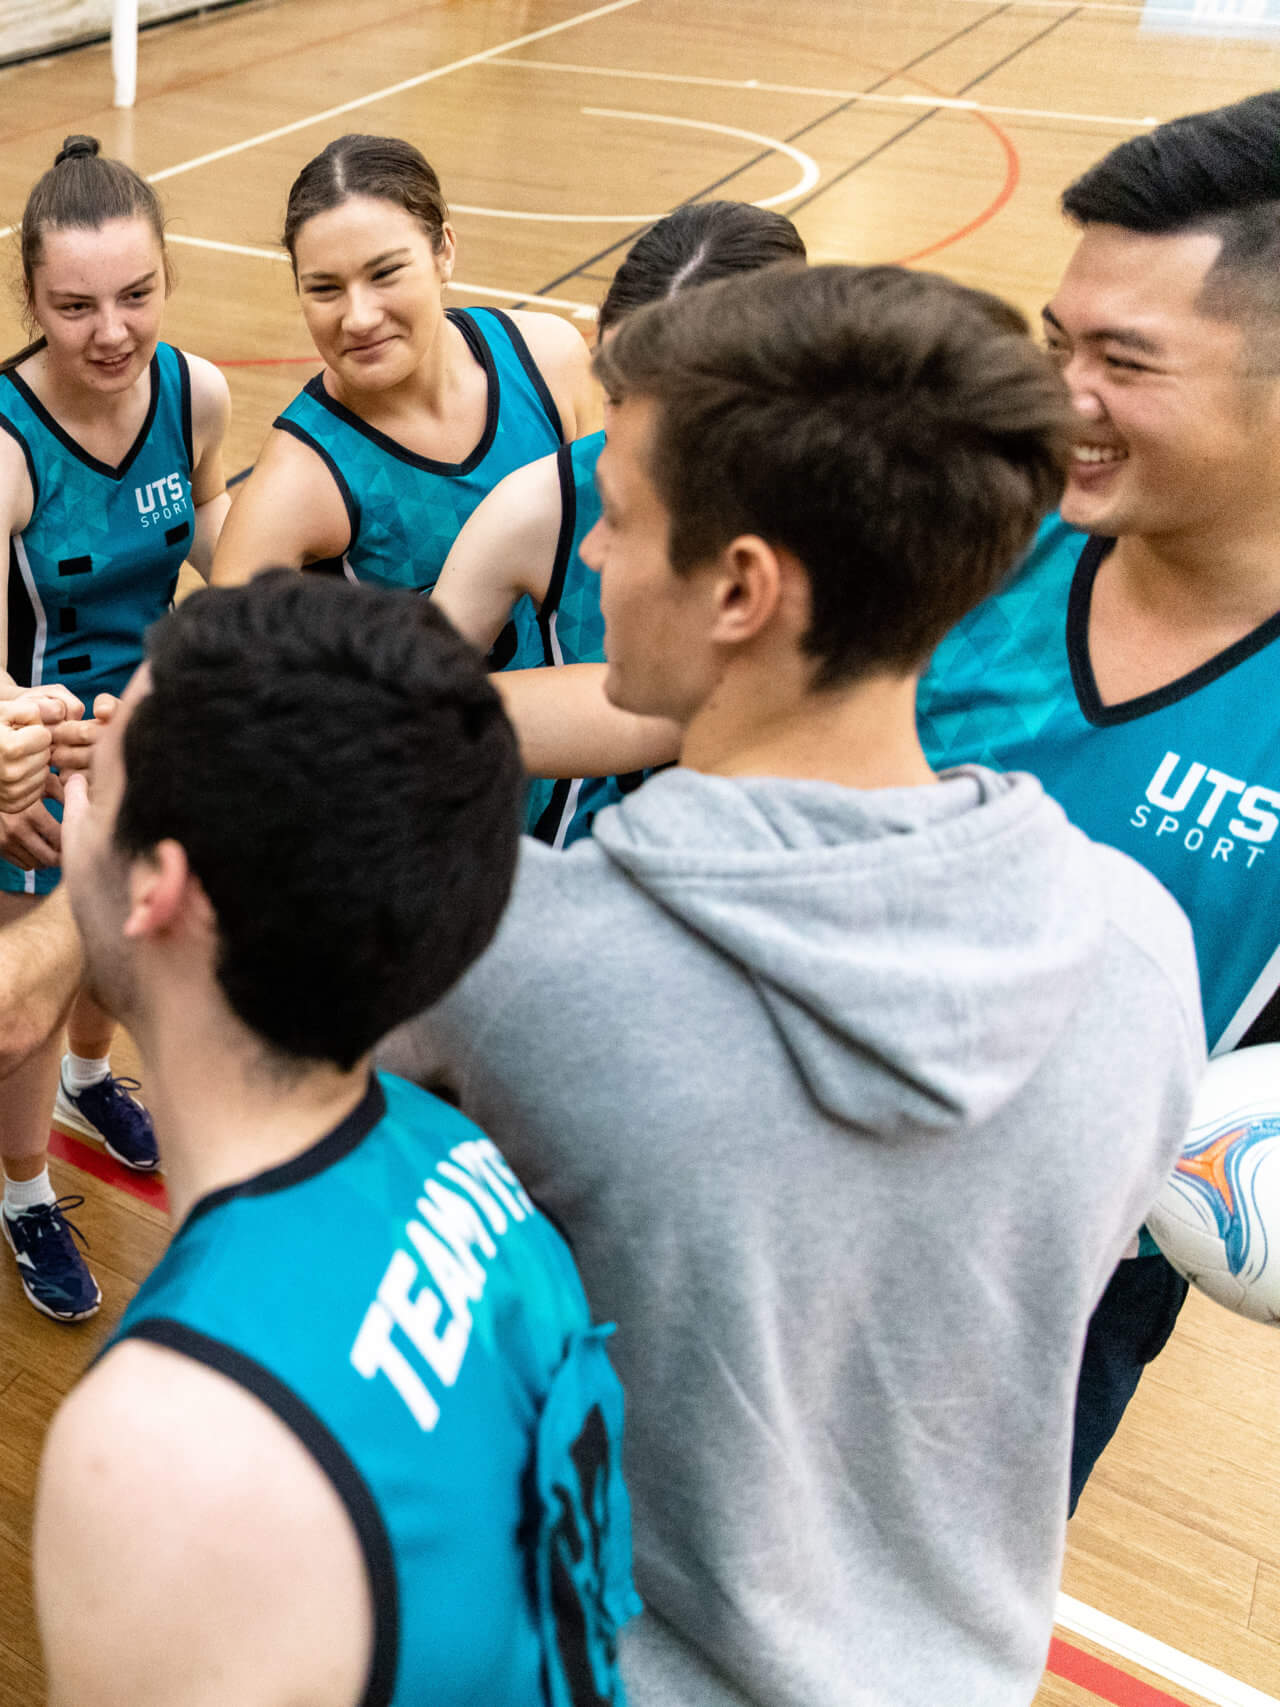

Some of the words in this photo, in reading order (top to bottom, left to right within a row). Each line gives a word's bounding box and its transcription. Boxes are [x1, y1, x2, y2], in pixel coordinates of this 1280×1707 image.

[135, 472, 183, 514] UTS
[140, 496, 188, 528] SPORT
[1145, 751, 1280, 843] UTS
[1129, 804, 1266, 869] SPORT
[350, 1178, 498, 1432] TEAM
